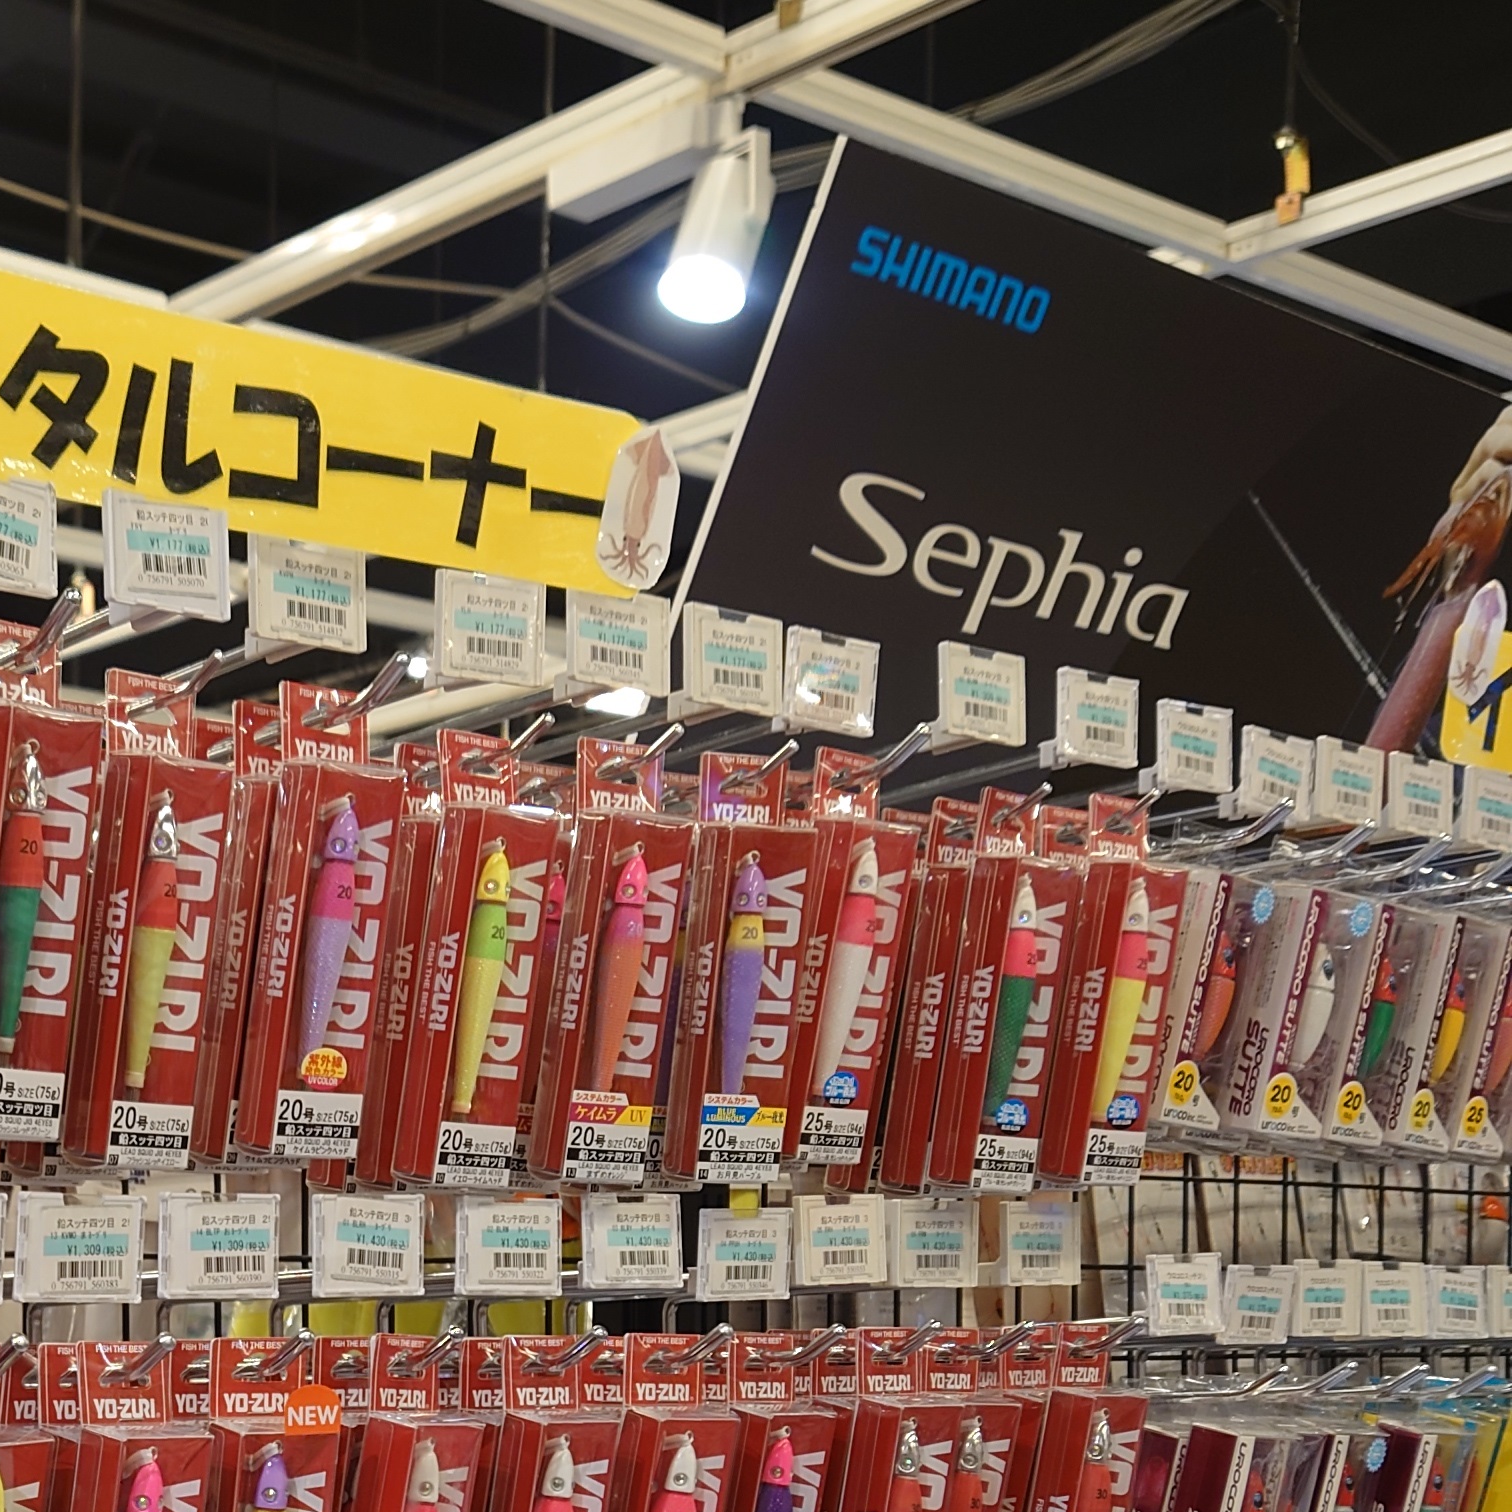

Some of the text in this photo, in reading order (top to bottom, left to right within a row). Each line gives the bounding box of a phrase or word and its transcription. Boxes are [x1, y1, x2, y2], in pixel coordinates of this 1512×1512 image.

[851, 225, 1051, 335] SHIMANO
[811, 471, 1190, 650] Sephia
[1174, 1071, 1194, 1091] 20
[516, 1385, 569, 1406] YO-ZURI
[93, 1397, 156, 1420] YO-ZURI
[288, 1405, 339, 1427] NEW
